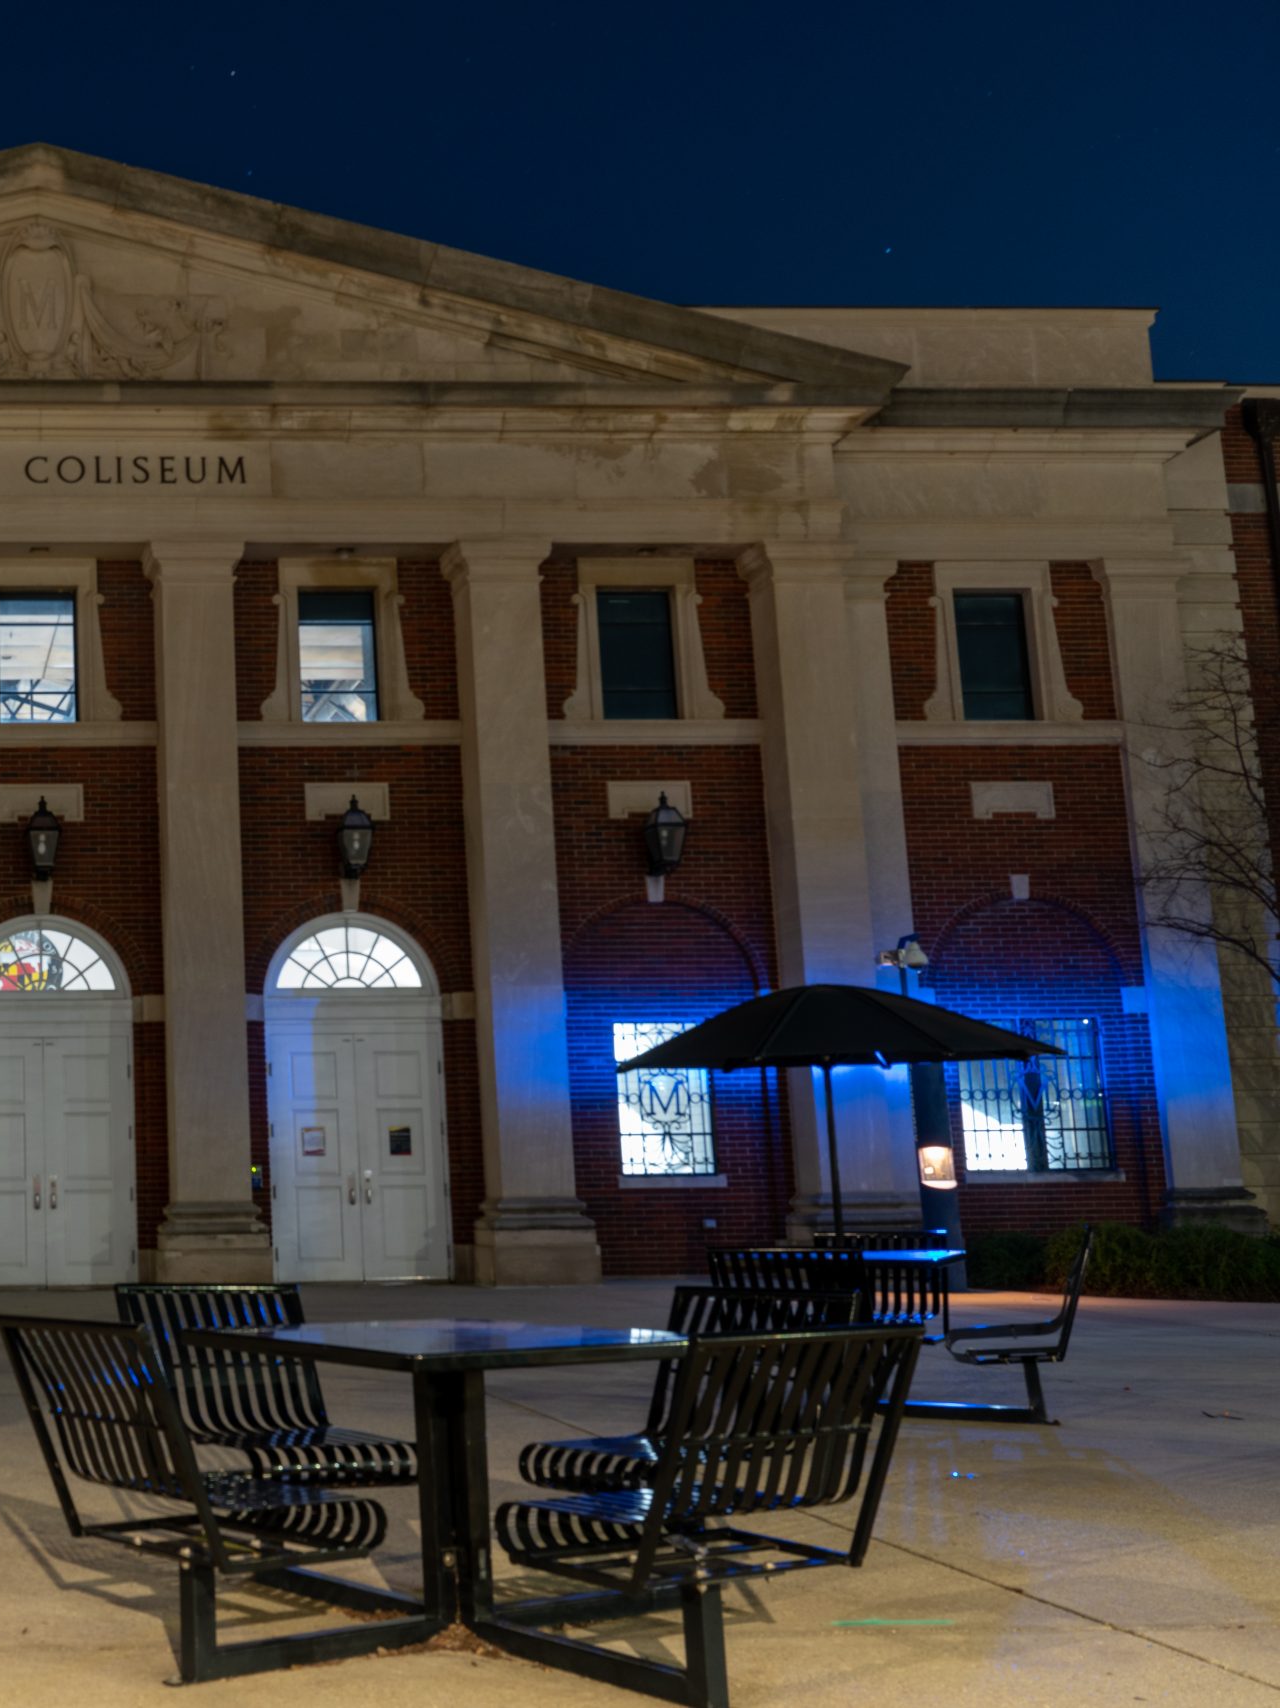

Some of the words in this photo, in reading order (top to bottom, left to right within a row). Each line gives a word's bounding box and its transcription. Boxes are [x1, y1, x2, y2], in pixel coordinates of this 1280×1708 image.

[17, 277, 58, 331] M
[24, 455, 248, 485] COLISEUM
[642, 1080, 687, 1116] M
